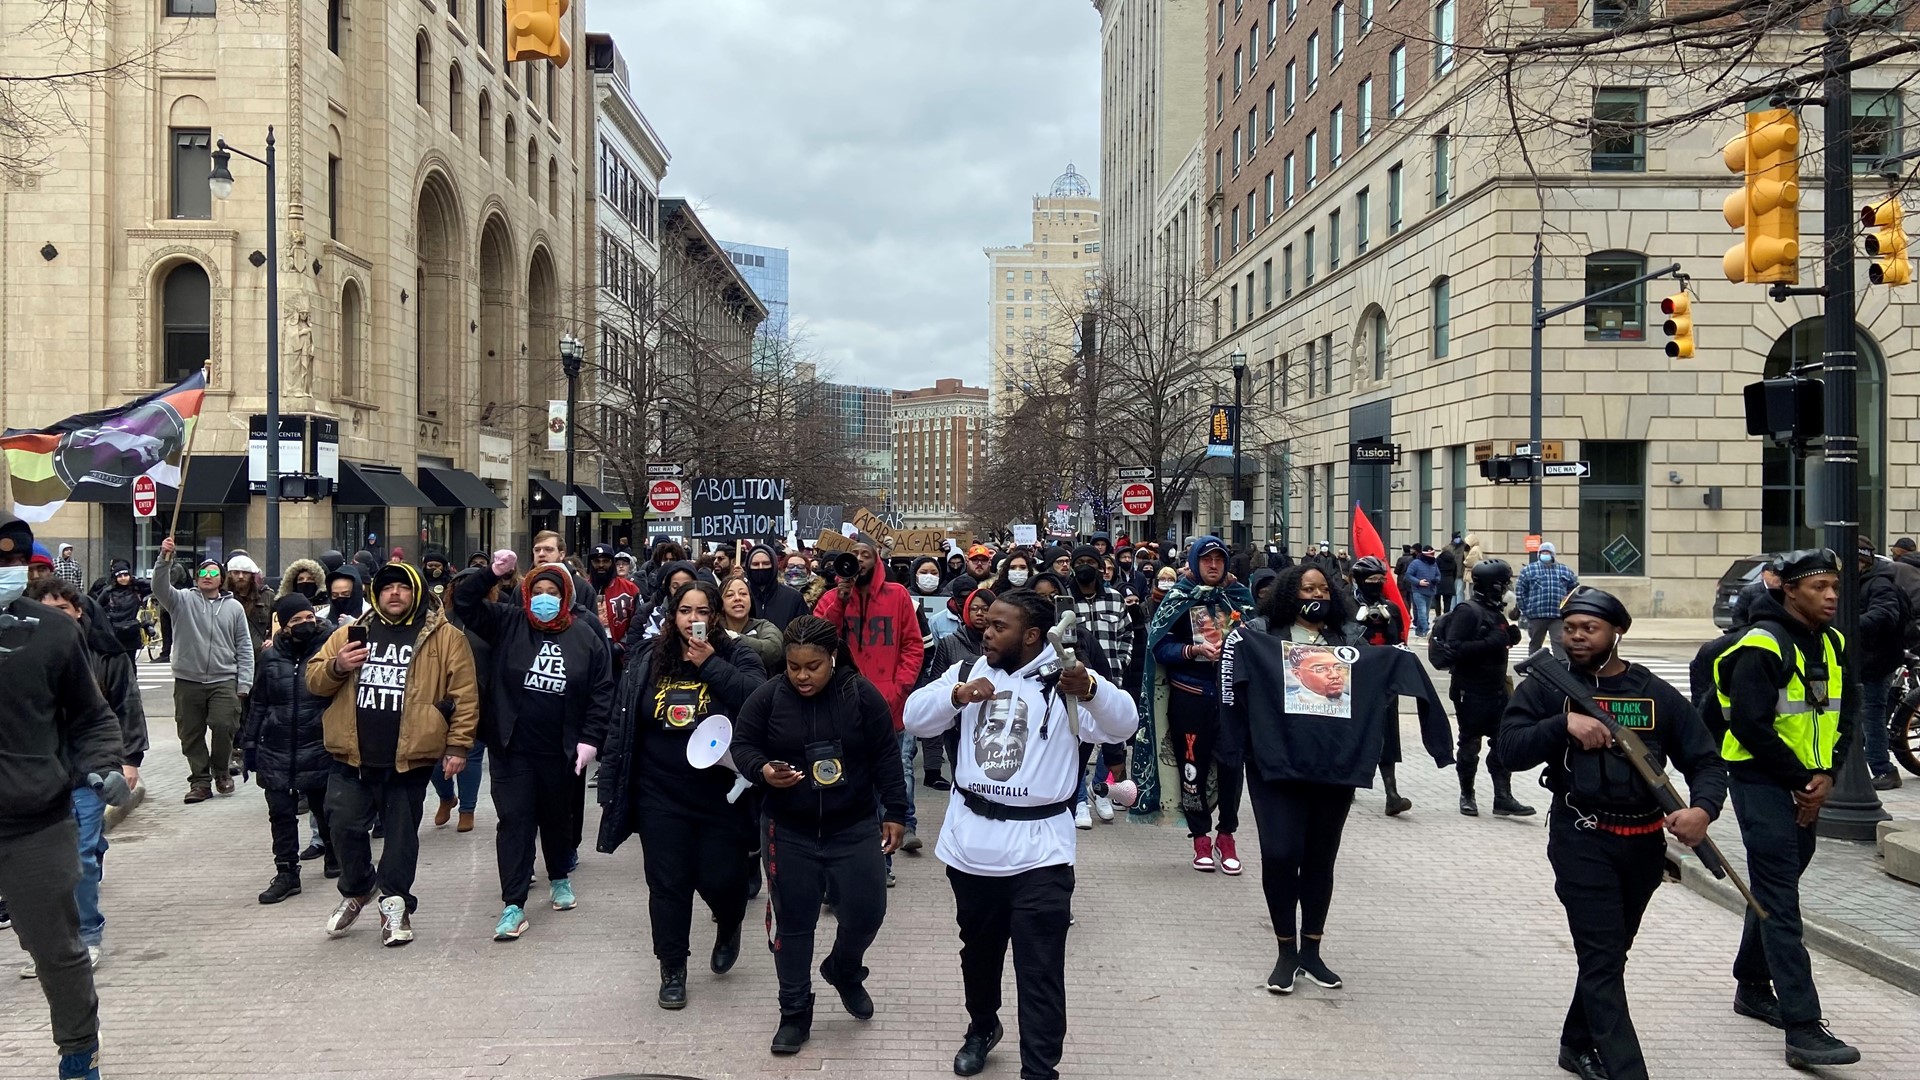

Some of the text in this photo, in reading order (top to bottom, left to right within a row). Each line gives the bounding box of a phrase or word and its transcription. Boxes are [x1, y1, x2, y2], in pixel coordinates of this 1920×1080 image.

[1356, 446, 1391, 457] fusion
[694, 478, 785, 501] ABOLITION
[138, 501, 152, 509] ENTER
[808, 505, 835, 521] OUR
[1221, 674, 1235, 706] JUSTICE
[1611, 702, 1641, 713] BLACK
[1617, 714, 1649, 726] PARTY
[968, 782, 1029, 797] #CONVICTALL4
